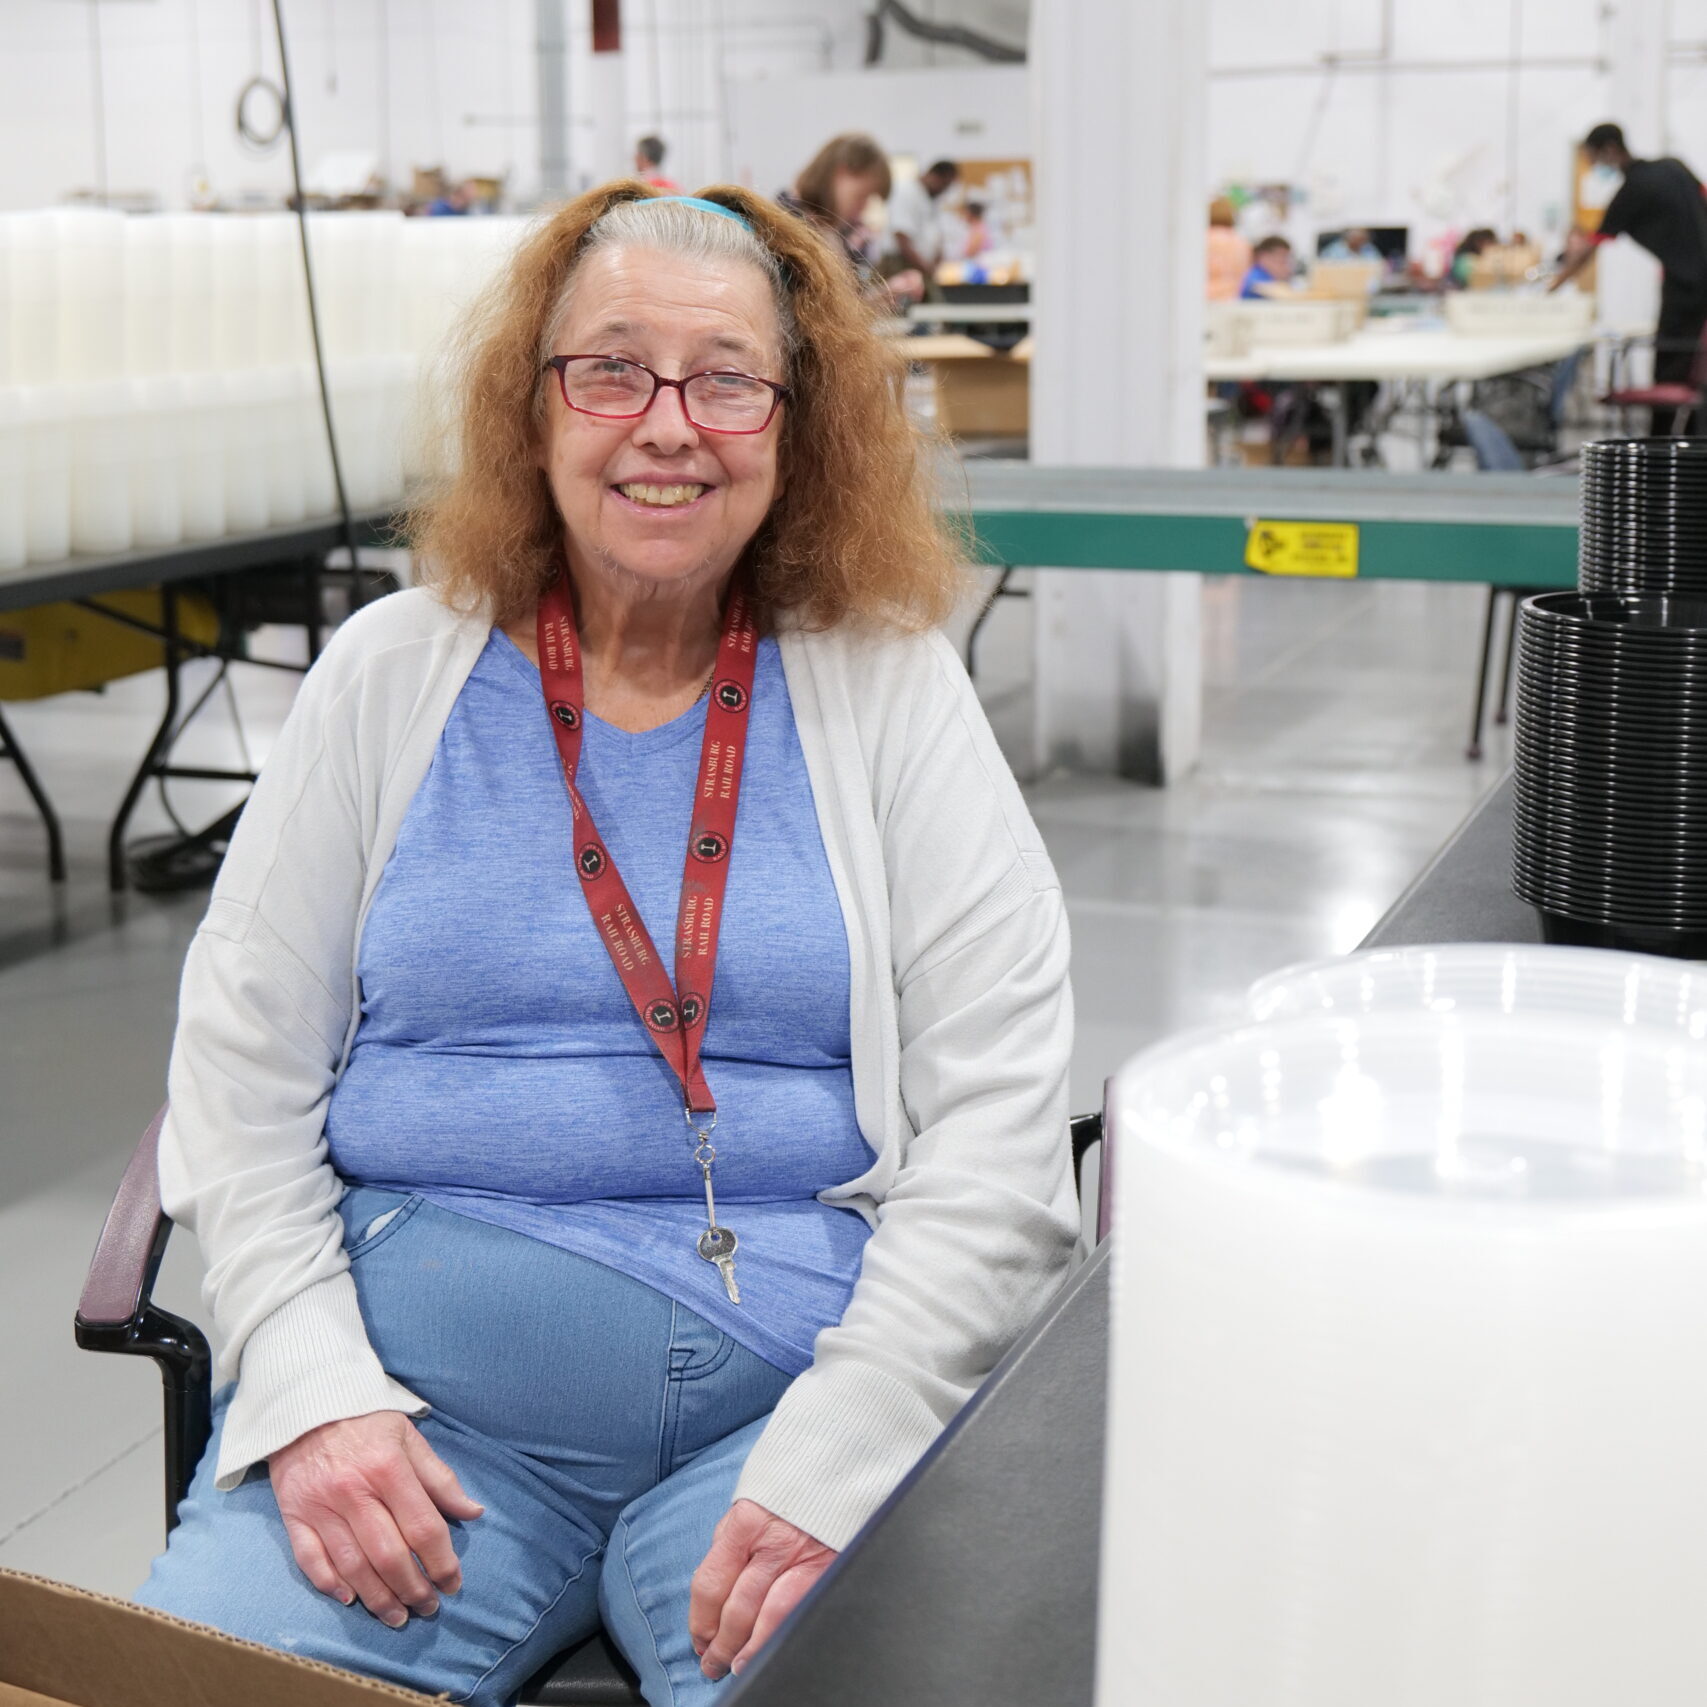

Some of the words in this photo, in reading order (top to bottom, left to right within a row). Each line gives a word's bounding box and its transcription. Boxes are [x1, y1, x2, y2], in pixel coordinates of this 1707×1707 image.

[560, 615, 575, 671] STRASBURG
[704, 740, 721, 799] STRASBURG
[614, 903, 652, 966] STRASBURG
[682, 895, 698, 959] STRASBURG
